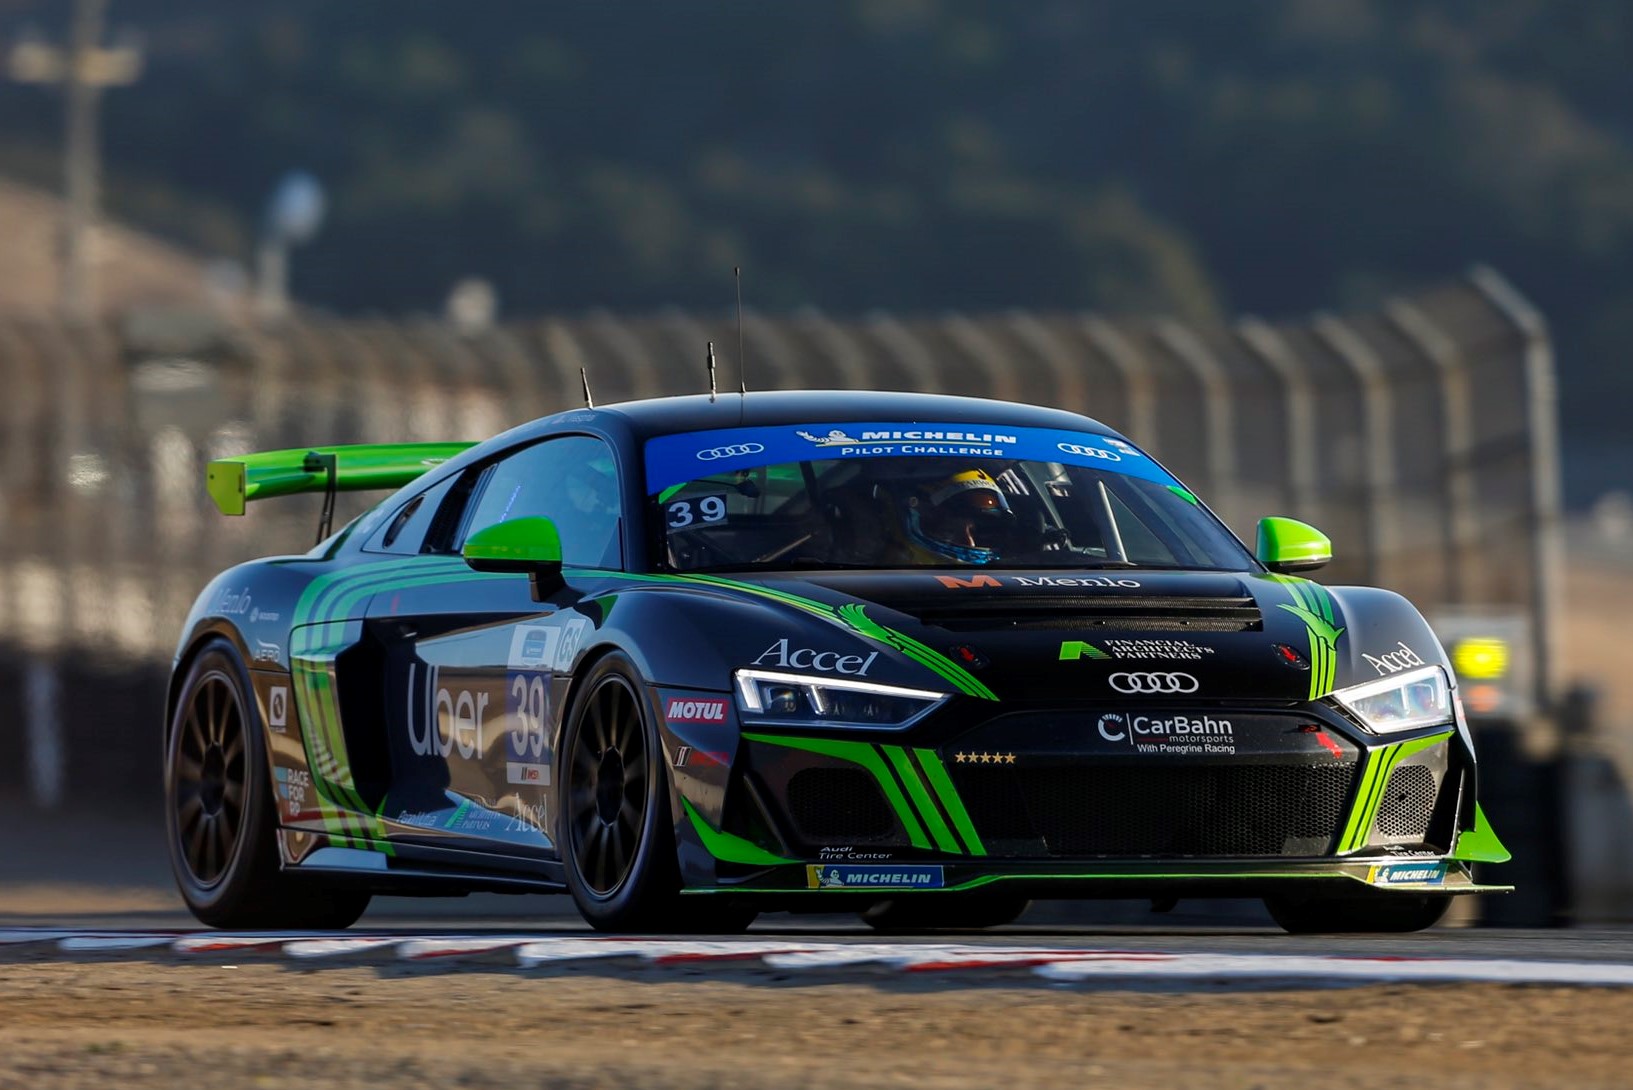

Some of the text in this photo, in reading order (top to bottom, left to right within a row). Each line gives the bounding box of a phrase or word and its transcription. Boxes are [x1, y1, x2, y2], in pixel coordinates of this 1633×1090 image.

[861, 430, 1017, 444] MICHELIN
[841, 444, 1004, 456] PILOT CHALLENGE
[668, 495, 726, 528] 39
[1011, 575, 1141, 589] Menlo
[253, 649, 281, 663] AERO
[751, 638, 879, 677] Accel
[1115, 651, 1202, 660] PARTNERS
[1362, 641, 1425, 677] Accel
[407, 662, 489, 760] Uber
[511, 674, 545, 758] 39
[667, 701, 724, 720] MOTUL
[1133, 715, 1233, 735] CarBahn
[1168, 734, 1235, 744] motorsports
[1136, 743, 1236, 755] With Peregrine Racing
[288, 768, 310, 788] RACE
[288, 786, 306, 803] FOR
[505, 791, 549, 833] Accel
[818, 852, 893, 860] Tire Center
[846, 873, 932, 884] MICHELIN
[1390, 869, 1440, 880] MICHELIN
